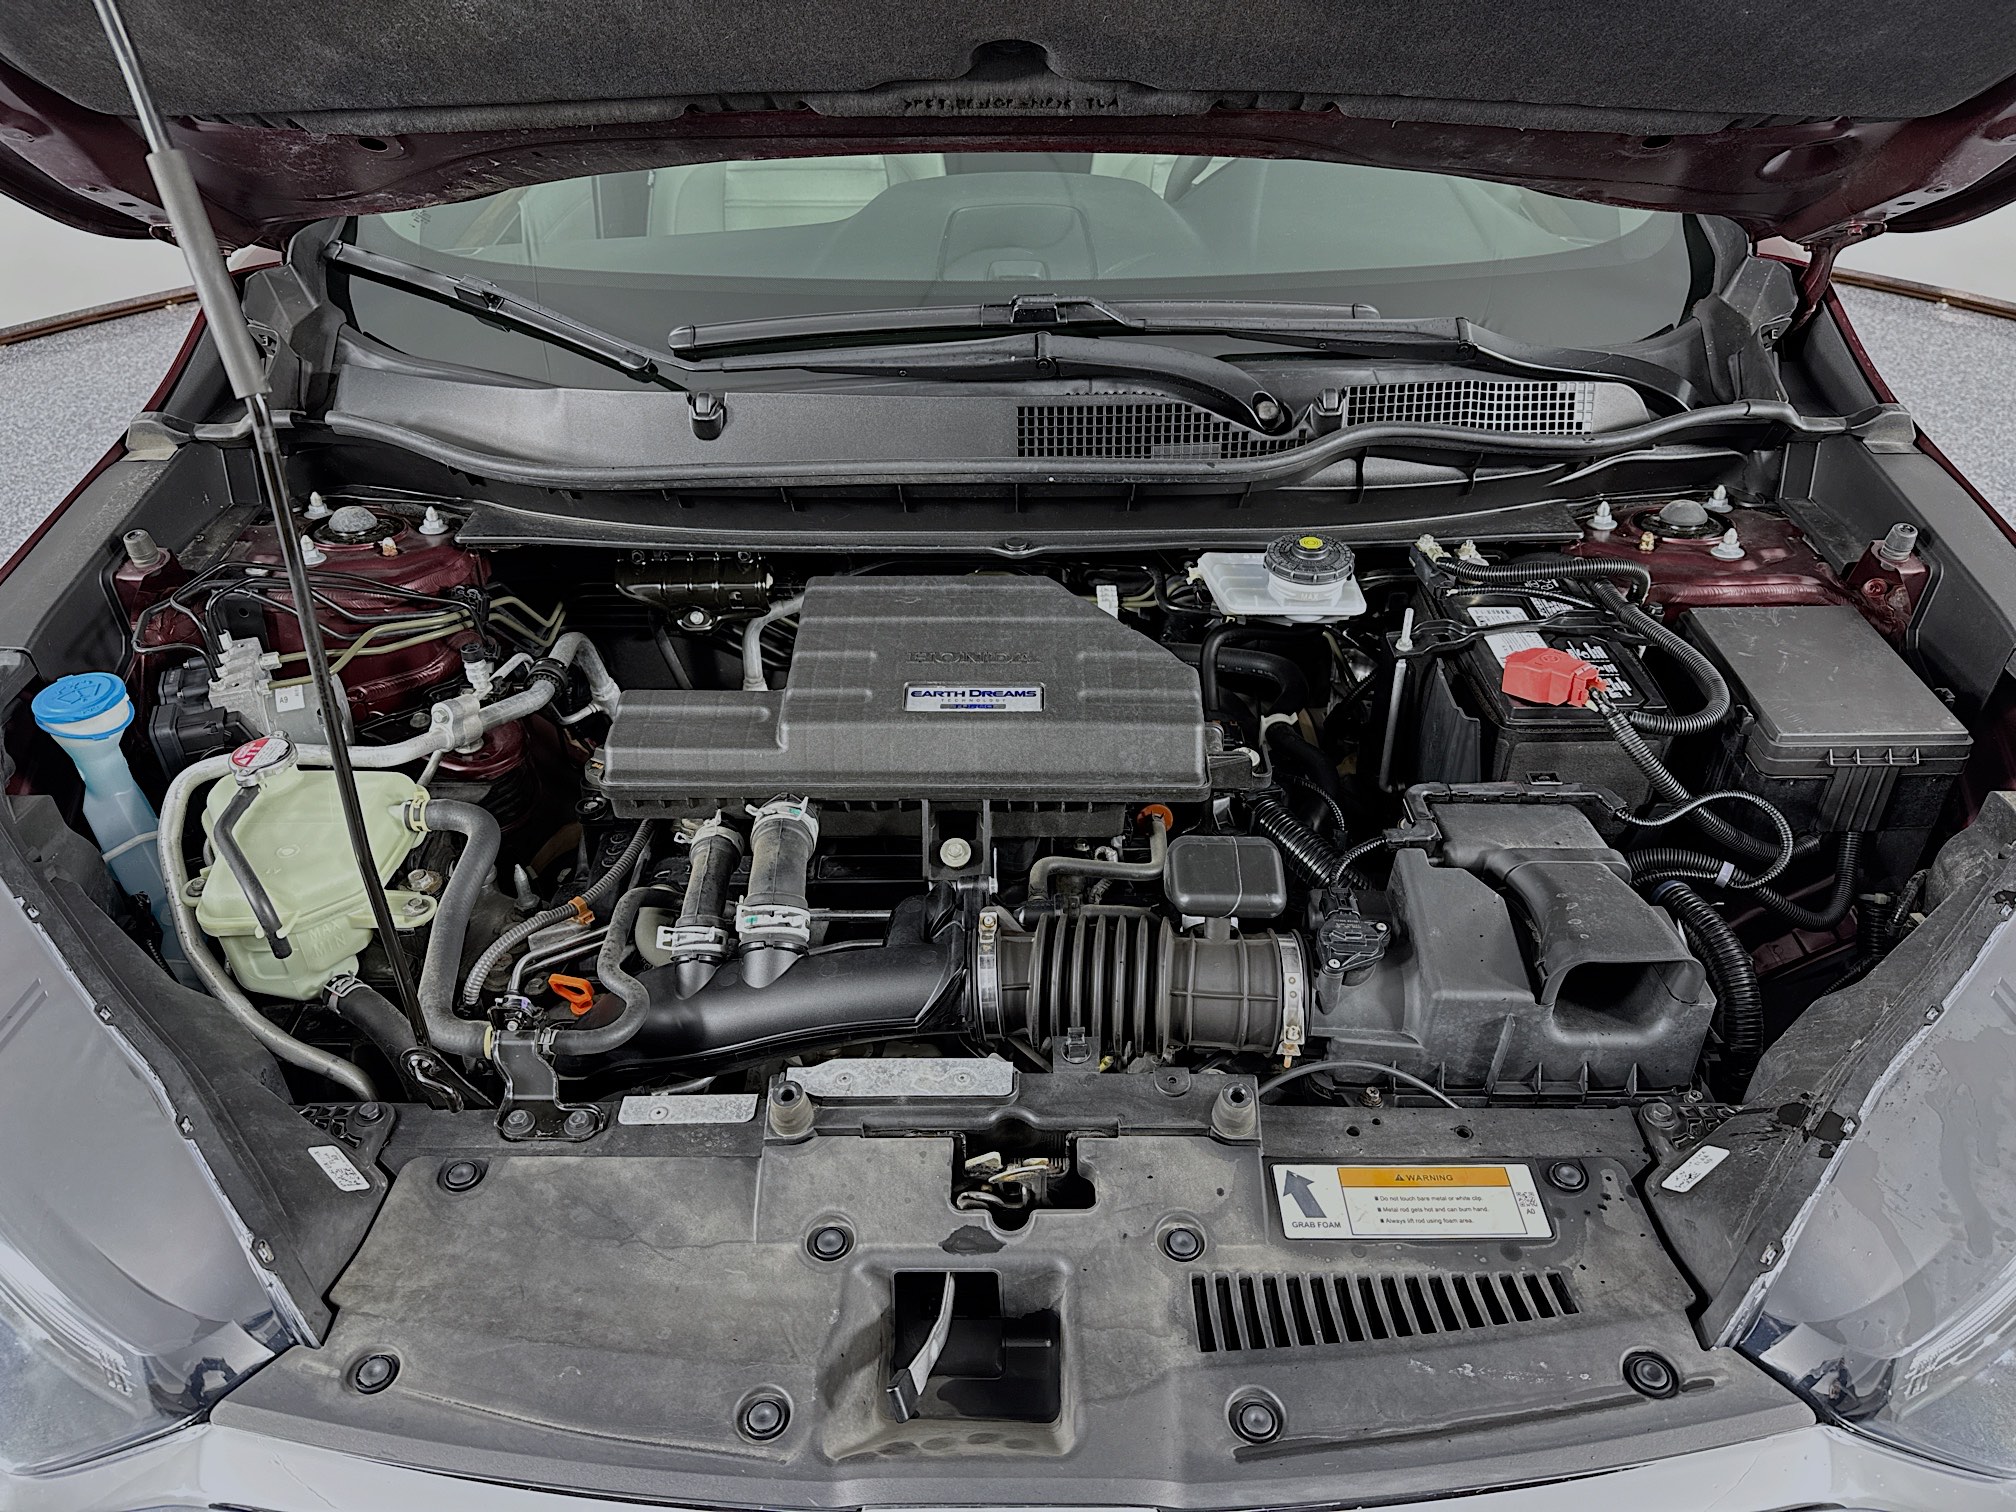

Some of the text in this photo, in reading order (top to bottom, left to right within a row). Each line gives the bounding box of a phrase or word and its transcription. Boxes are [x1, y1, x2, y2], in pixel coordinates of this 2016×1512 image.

[1300, 592, 1319, 601] MAX
[905, 650, 1041, 664] HONDA
[910, 689, 1037, 698] EARTH DREAMS
[1405, 1174, 1454, 1182] WARNING
[1317, 1221, 1341, 1229] FOAM
